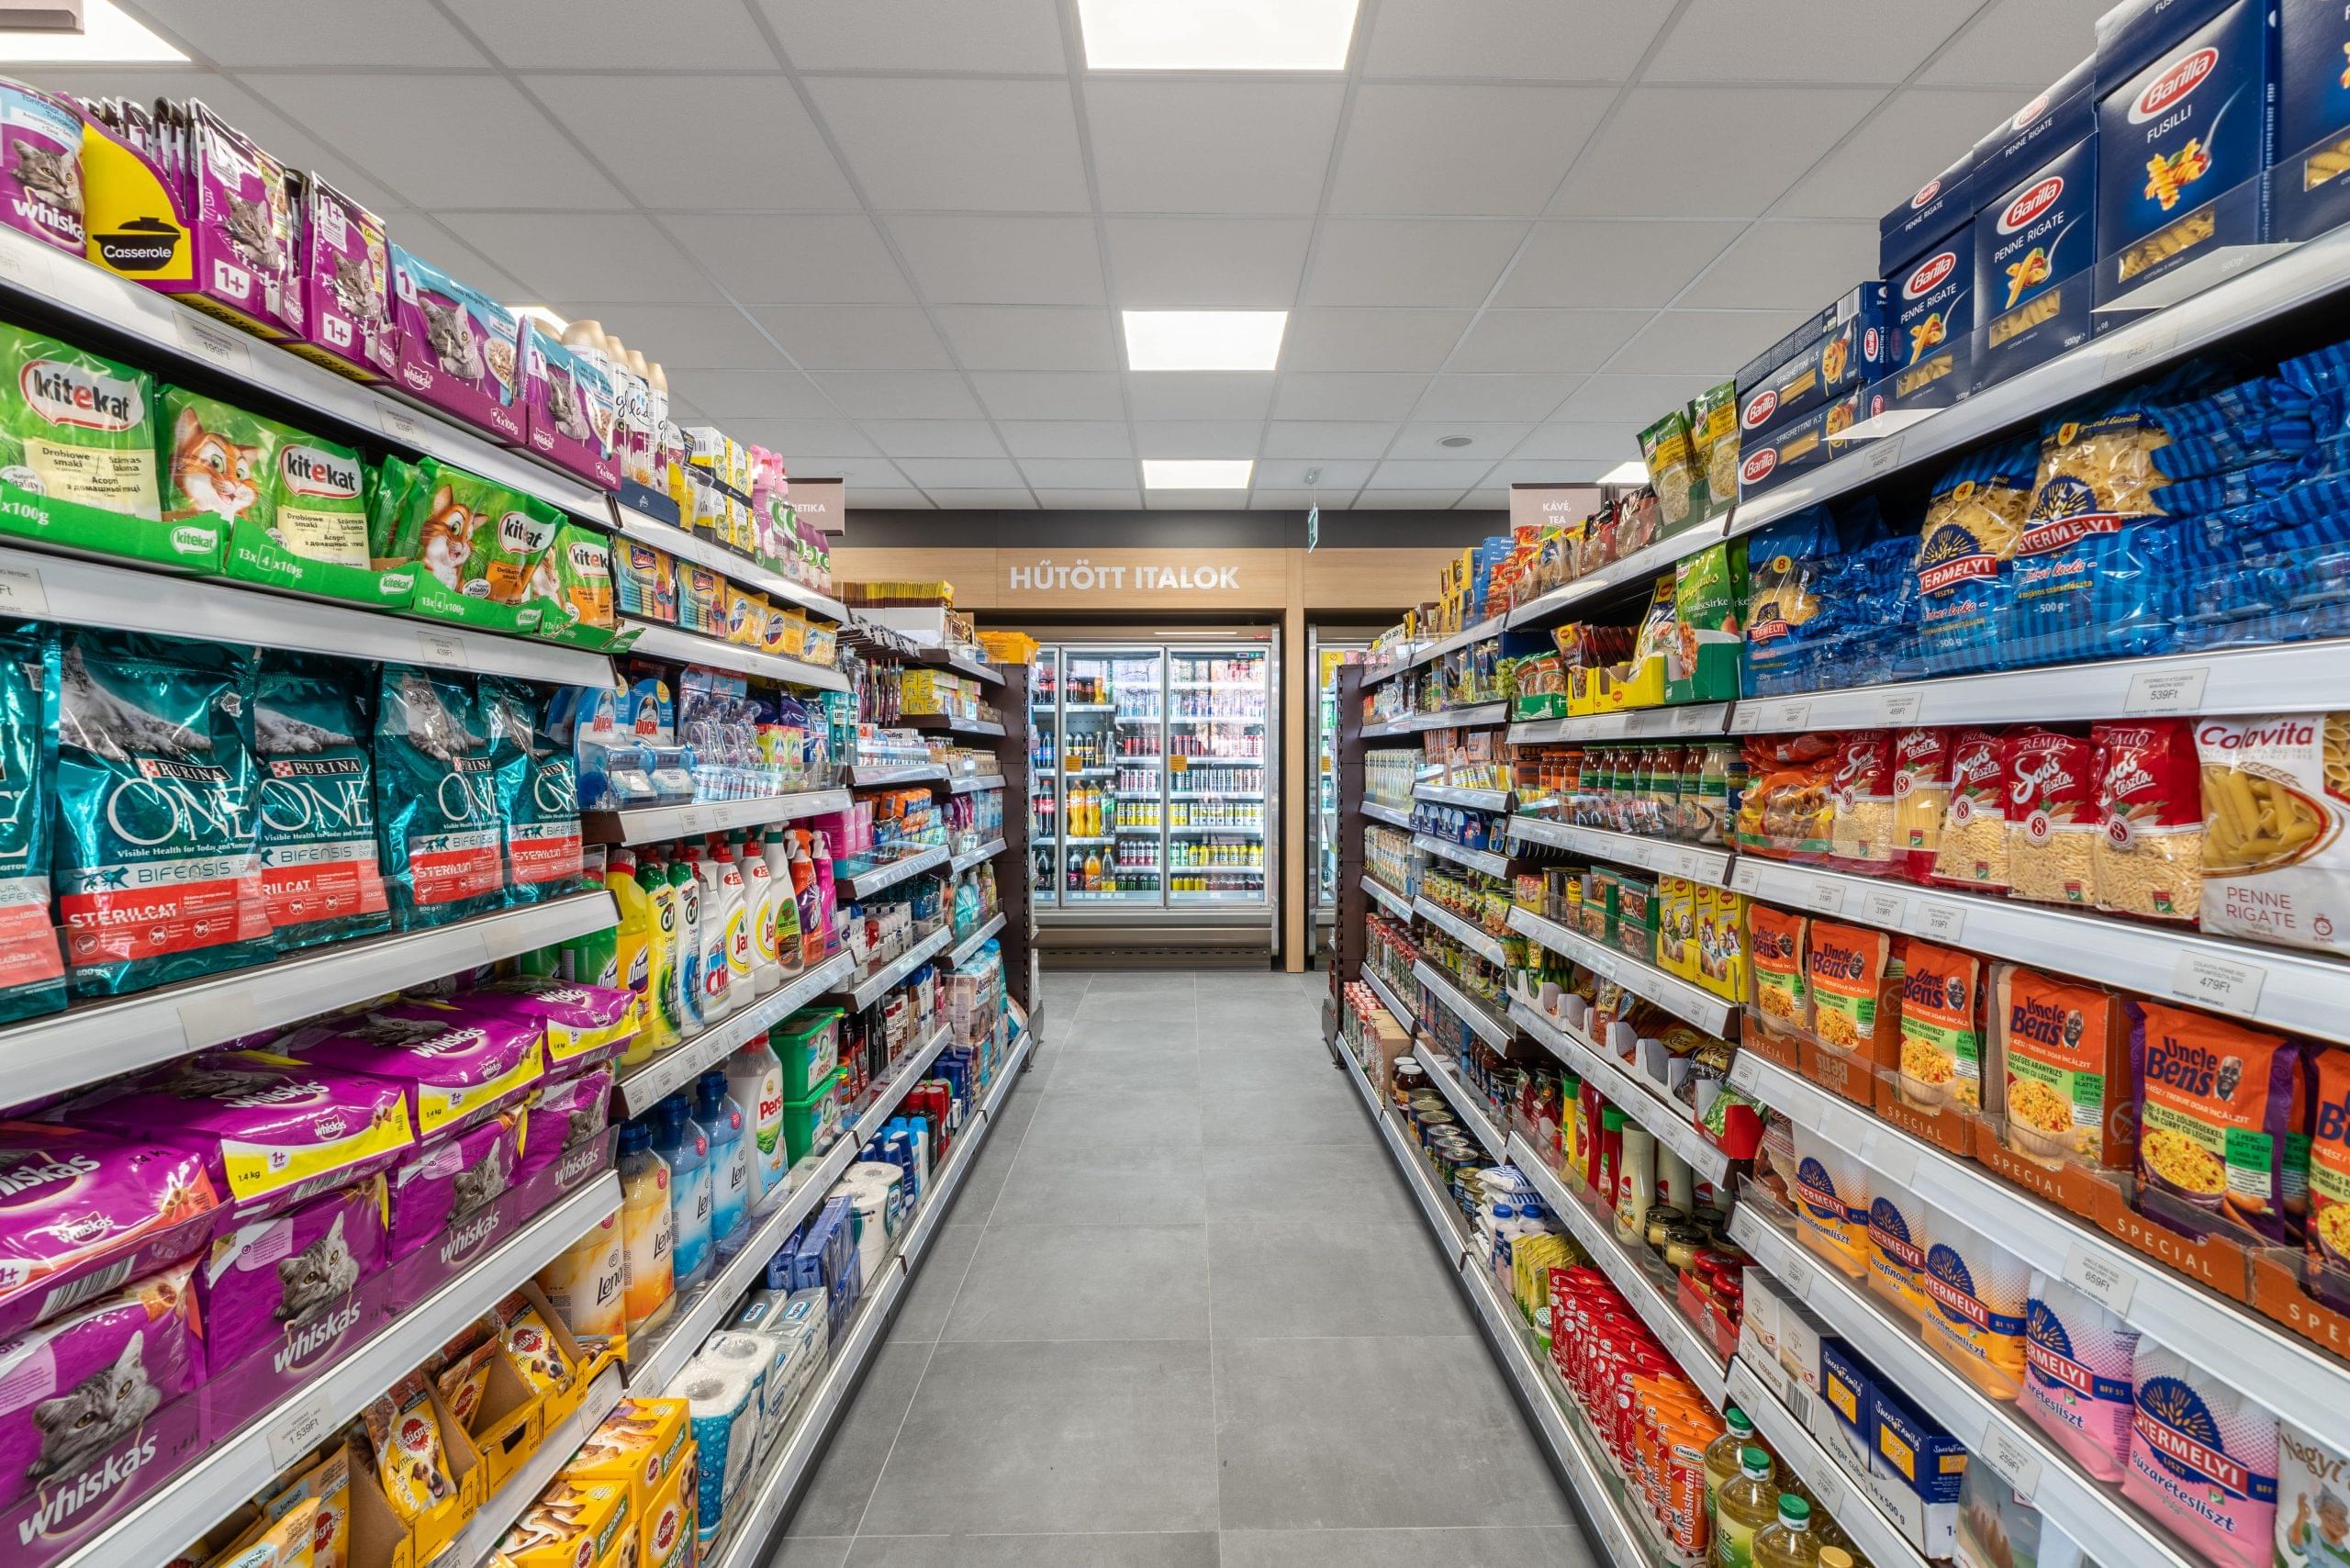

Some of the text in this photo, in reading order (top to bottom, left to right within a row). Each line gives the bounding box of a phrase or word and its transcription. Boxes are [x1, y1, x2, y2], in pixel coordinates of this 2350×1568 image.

[2146, 53, 2211, 112] Barilla
[2147, 105, 2192, 143] FUSILLI
[2005, 118, 2053, 157] PENNE RIGATE
[1918, 184, 1939, 204] Barilla
[2011, 181, 2058, 225] Barilla
[1905, 201, 1943, 231] PENNE RIGATE
[1994, 212, 2065, 263] PENNE RIGATE
[104, 245, 172, 259] Casserole
[219, 265, 245, 293] 1+
[1915, 257, 1953, 289] Barilla
[1900, 285, 1957, 324] PENNE RIGATE
[327, 319, 348, 342] 1+
[1867, 330, 1875, 359] Barilla
[1776, 360, 1809, 386] SPAGHETTINI
[34, 369, 129, 421] kitekat
[1748, 396, 1774, 423] Barilla
[1776, 421, 1812, 444] SPAGHETTINI
[42, 448, 91, 462] Drobiowe
[53, 459, 83, 469] smaki
[1747, 454, 1774, 478] Barilla
[286, 454, 356, 491] kitekat
[1959, 485, 1968, 496] 4
[1543, 499, 1572, 511] KÁVÉ,
[286, 513, 324, 523] Drobiowe
[295, 521, 318, 529] smaki
[175, 530, 216, 548] kitekat
[239, 547, 270, 566] 13x 4
[1777, 559, 1786, 570] 8
[383, 577, 412, 590] kitekat
[1011, 559, 1240, 589] HŰTÖTT ITALOK
[1919, 560, 1990, 588] YERMELYI
[2040, 603, 2056, 613] 500
[1941, 638, 1954, 647] 500
[2151, 689, 2178, 700] 539Ft
[635, 718, 657, 734] DUCK
[2199, 722, 2314, 749] Colavita
[1908, 739, 1940, 758] tészta
[295, 760, 360, 775] PURINA
[1969, 761, 2000, 781] tészta
[1899, 778, 1908, 791] 8
[2042, 772, 2074, 796] tészta
[2116, 770, 2154, 796] tészta
[107, 778, 256, 845] ONE
[262, 778, 374, 831] ONE
[1958, 801, 1967, 817] 8
[264, 834, 291, 842] Visible
[293, 832, 316, 840] Health
[2035, 818, 2044, 835] 8
[2112, 824, 2123, 840] 8
[118, 848, 150, 859] Visible
[152, 845, 181, 857] Health
[184, 845, 195, 854] for
[196, 844, 216, 856] Today
[281, 846, 352, 863] BIFENSIS
[139, 861, 230, 884] BIFENSIS
[263, 880, 311, 896] RILCAT
[2226, 886, 2291, 910] PENNE
[69, 902, 177, 929] STERILCAT
[2226, 903, 2296, 929] RIGATE
[1757, 925, 1777, 942] Uncle
[1824, 943, 1852, 962] Uncle
[1916, 969, 1943, 990] Uncle
[2199, 977, 2231, 992] 479Ft
[2026, 996, 2065, 1024] Uncle
[1919, 1021, 1945, 1037] ARANYRIZS
[2011, 1005, 2060, 1047] Ben's
[411, 1028, 487, 1058] whiskas
[1751, 1036, 1785, 1061] SPECIAL
[2164, 1036, 2218, 1070] Uncle
[2030, 1061, 2063, 1078] ARANYRIZS
[2038, 1072, 2058, 1085] LEGUME
[2146, 1046, 2214, 1097] Ben's
[2162, 1109, 2175, 1121] RIZS
[2190, 1101, 2209, 1114] DOAR
[315, 1120, 346, 1136] whiskas
[1888, 1106, 1942, 1141] SPECIAL
[2160, 1118, 2218, 1146] CURRY CU LEGUME
[238, 1170, 261, 1182] 1.4 kg
[554, 1146, 599, 1187] whiskas
[1993, 1154, 2065, 1199] SPECIAL
[440, 1209, 499, 1264] whiskas
[2118, 1218, 2213, 1277] SPECIAL
[2085, 1271, 2109, 1294] 659Ft
[274, 1302, 361, 1374] whiskas
[2027, 1341, 2086, 1387] ERMELYI
[297, 1418, 319, 1440] 539Ft
[397, 1420, 434, 1452] Pedigree
[2134, 1409, 2239, 1486] GYERMELYI
[2280, 1431, 2348, 1484] Nagyi
[393, 1452, 415, 1473] VITAL
[1829, 1436, 1847, 1459] Sugar
[1885, 1498, 1900, 1518] 500
[18, 1433, 158, 1547] whiskas
[2132, 1449, 2237, 1533] Búzarétesliszt
[277, 1490, 303, 1515] JUNIOR
[1681, 1469, 1695, 1546] Gulyáskrém
[315, 1508, 346, 1540] igree
